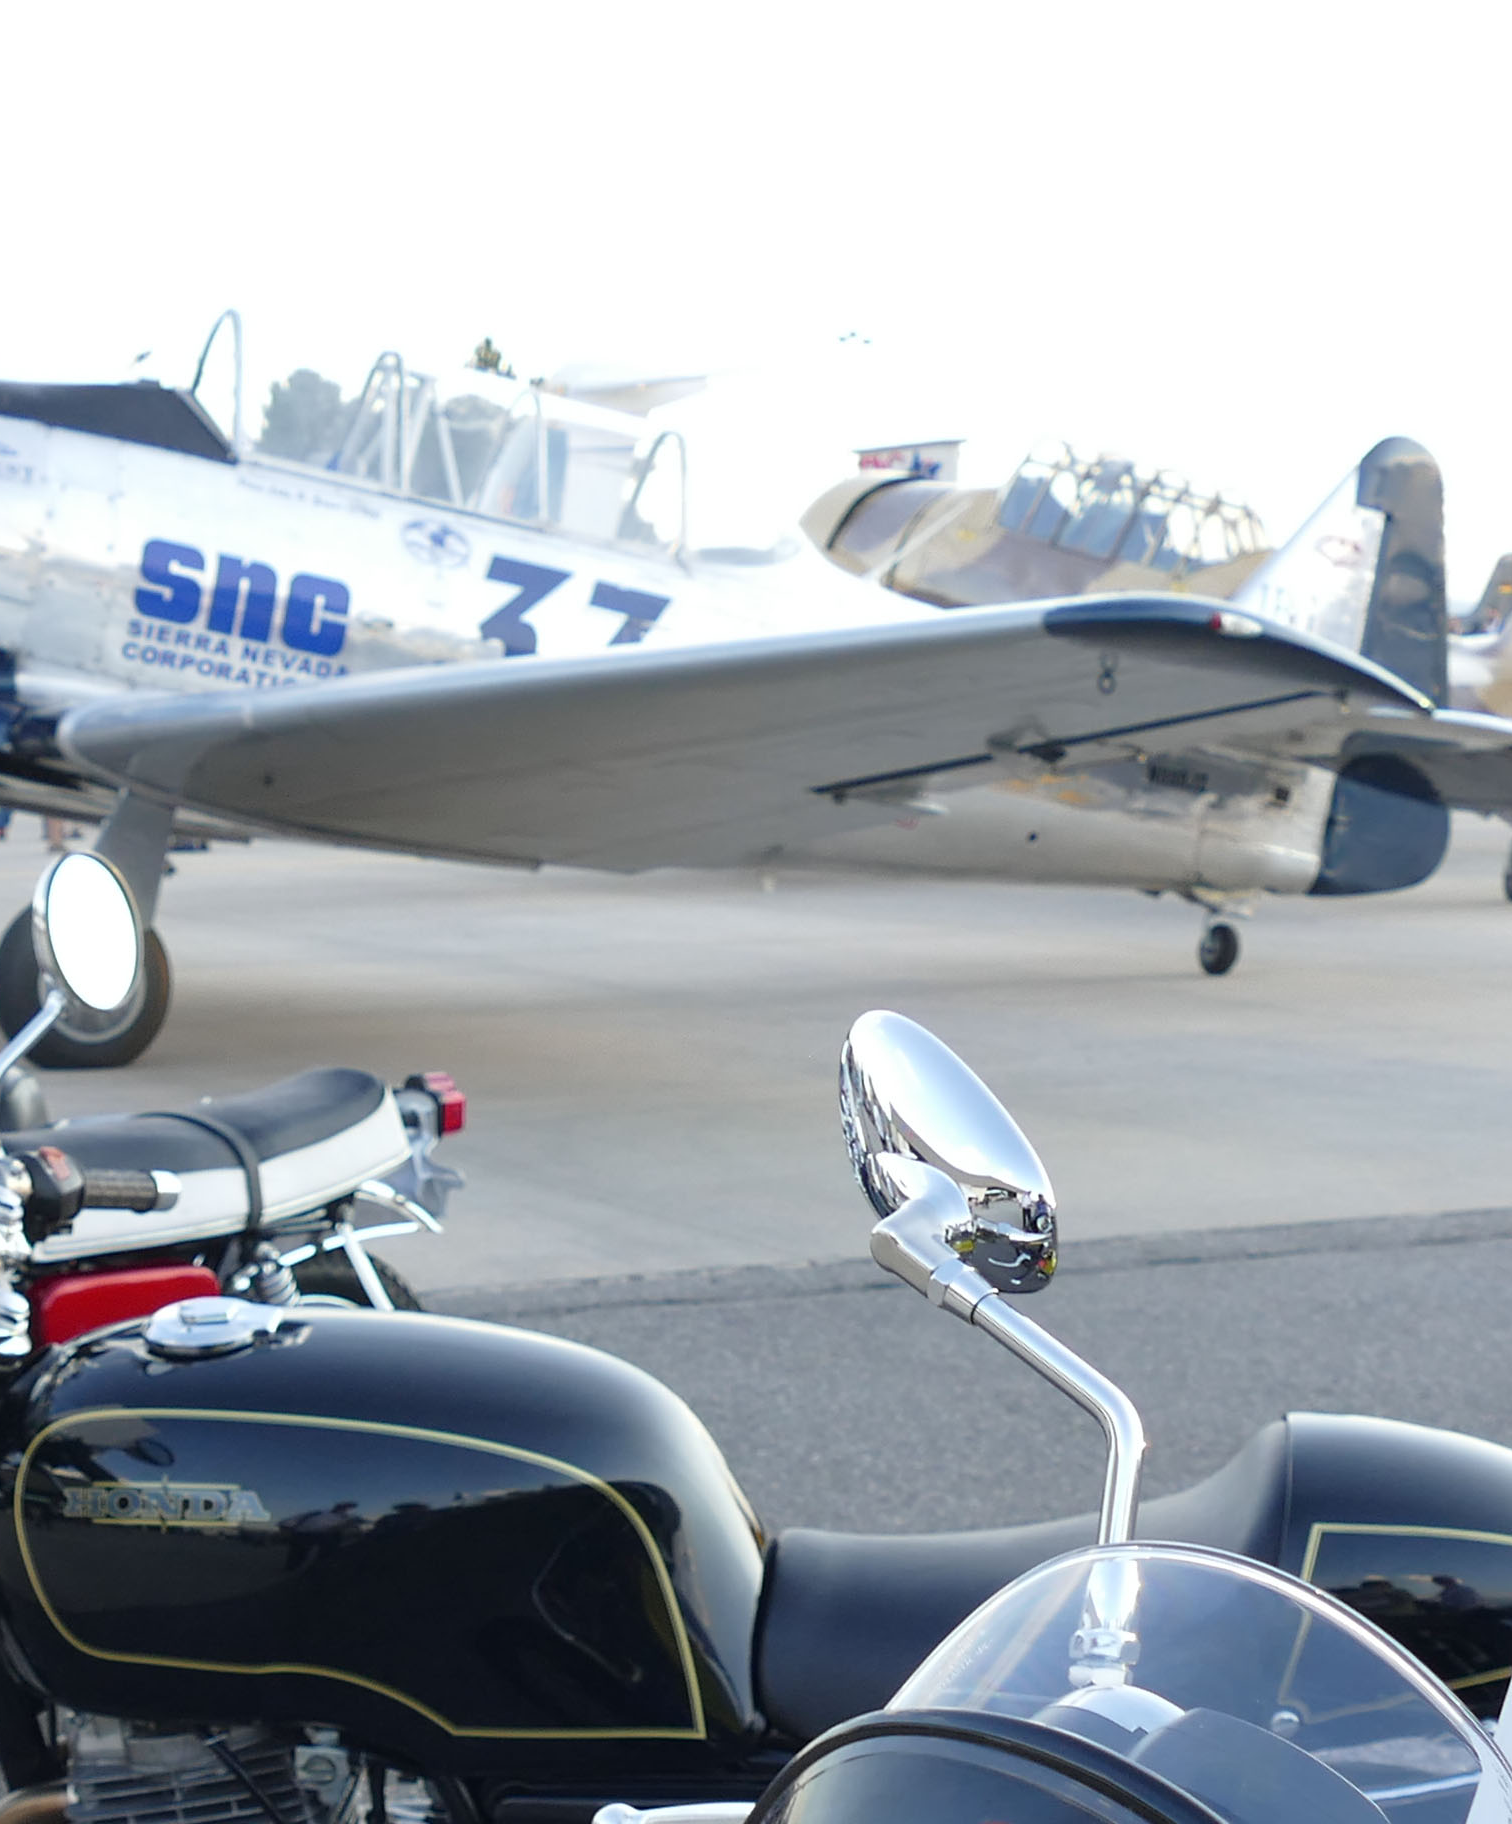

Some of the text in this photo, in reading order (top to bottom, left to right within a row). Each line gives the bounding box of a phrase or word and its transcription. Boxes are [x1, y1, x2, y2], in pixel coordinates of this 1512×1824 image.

[122, 641, 298, 688] CORPORATI
[127, 618, 350, 679] SIERRA NEVADA
[63, 1486, 272, 1523] HONDA
